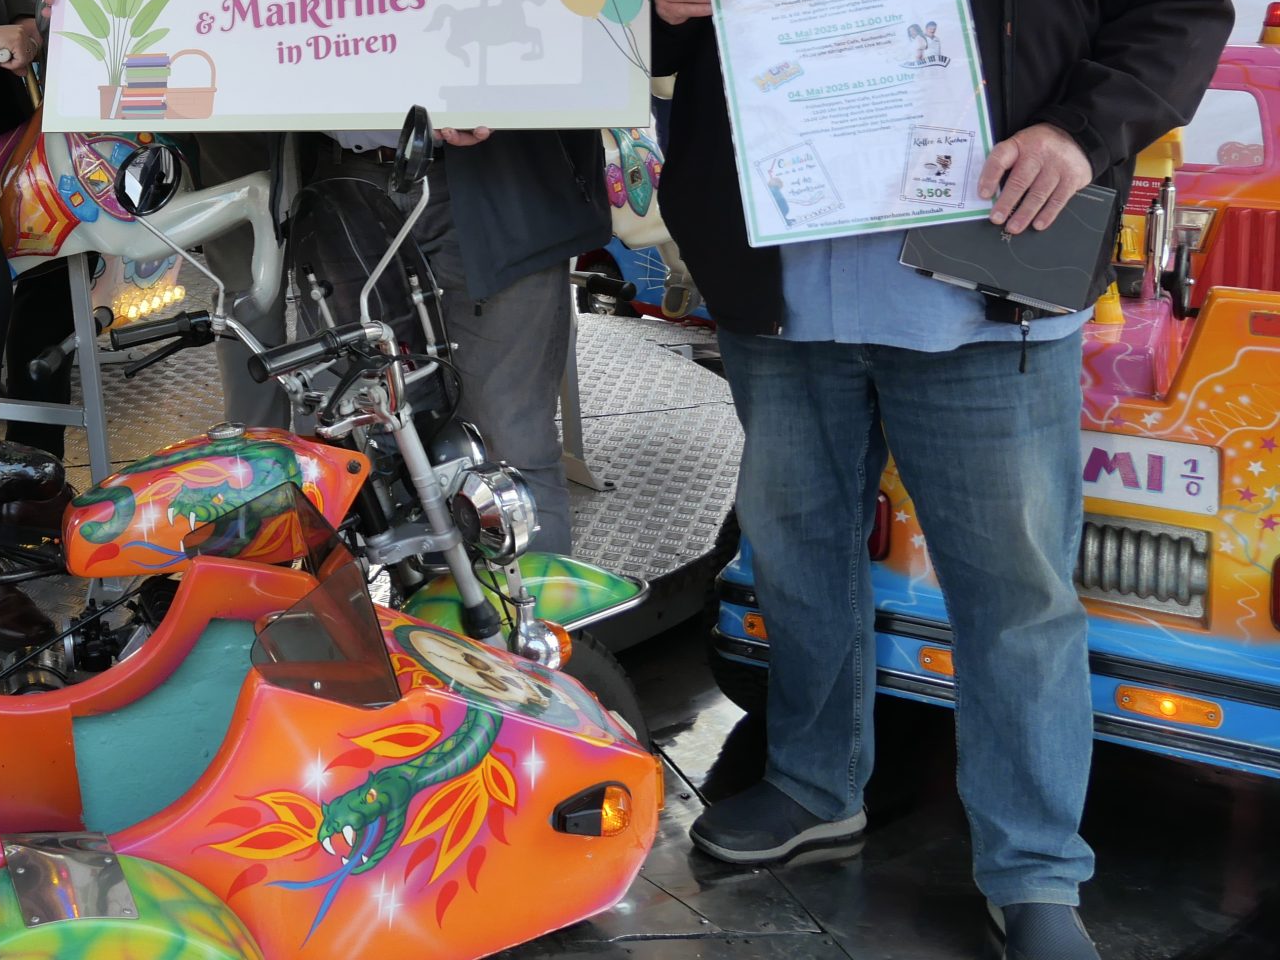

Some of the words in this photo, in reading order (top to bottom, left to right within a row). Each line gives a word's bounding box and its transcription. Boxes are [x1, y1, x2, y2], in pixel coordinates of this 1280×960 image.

[196, 12, 215, 34] &
[814, 24, 838, 36] 2025
[840, 22, 852, 31] ab
[855, 17, 882, 28] 11.00
[883, 13, 904, 24] Uhr
[277, 42, 302, 64] in
[306, 33, 397, 61] Düren
[806, 87, 824, 97] Mai
[826, 82, 850, 94] 2025
[852, 80, 864, 90] ab
[866, 75, 894, 87] 11.00
[896, 71, 915, 82] Uhr
[916, 188, 952, 199] 3,50€
[1083, 447, 1164, 492] MI
